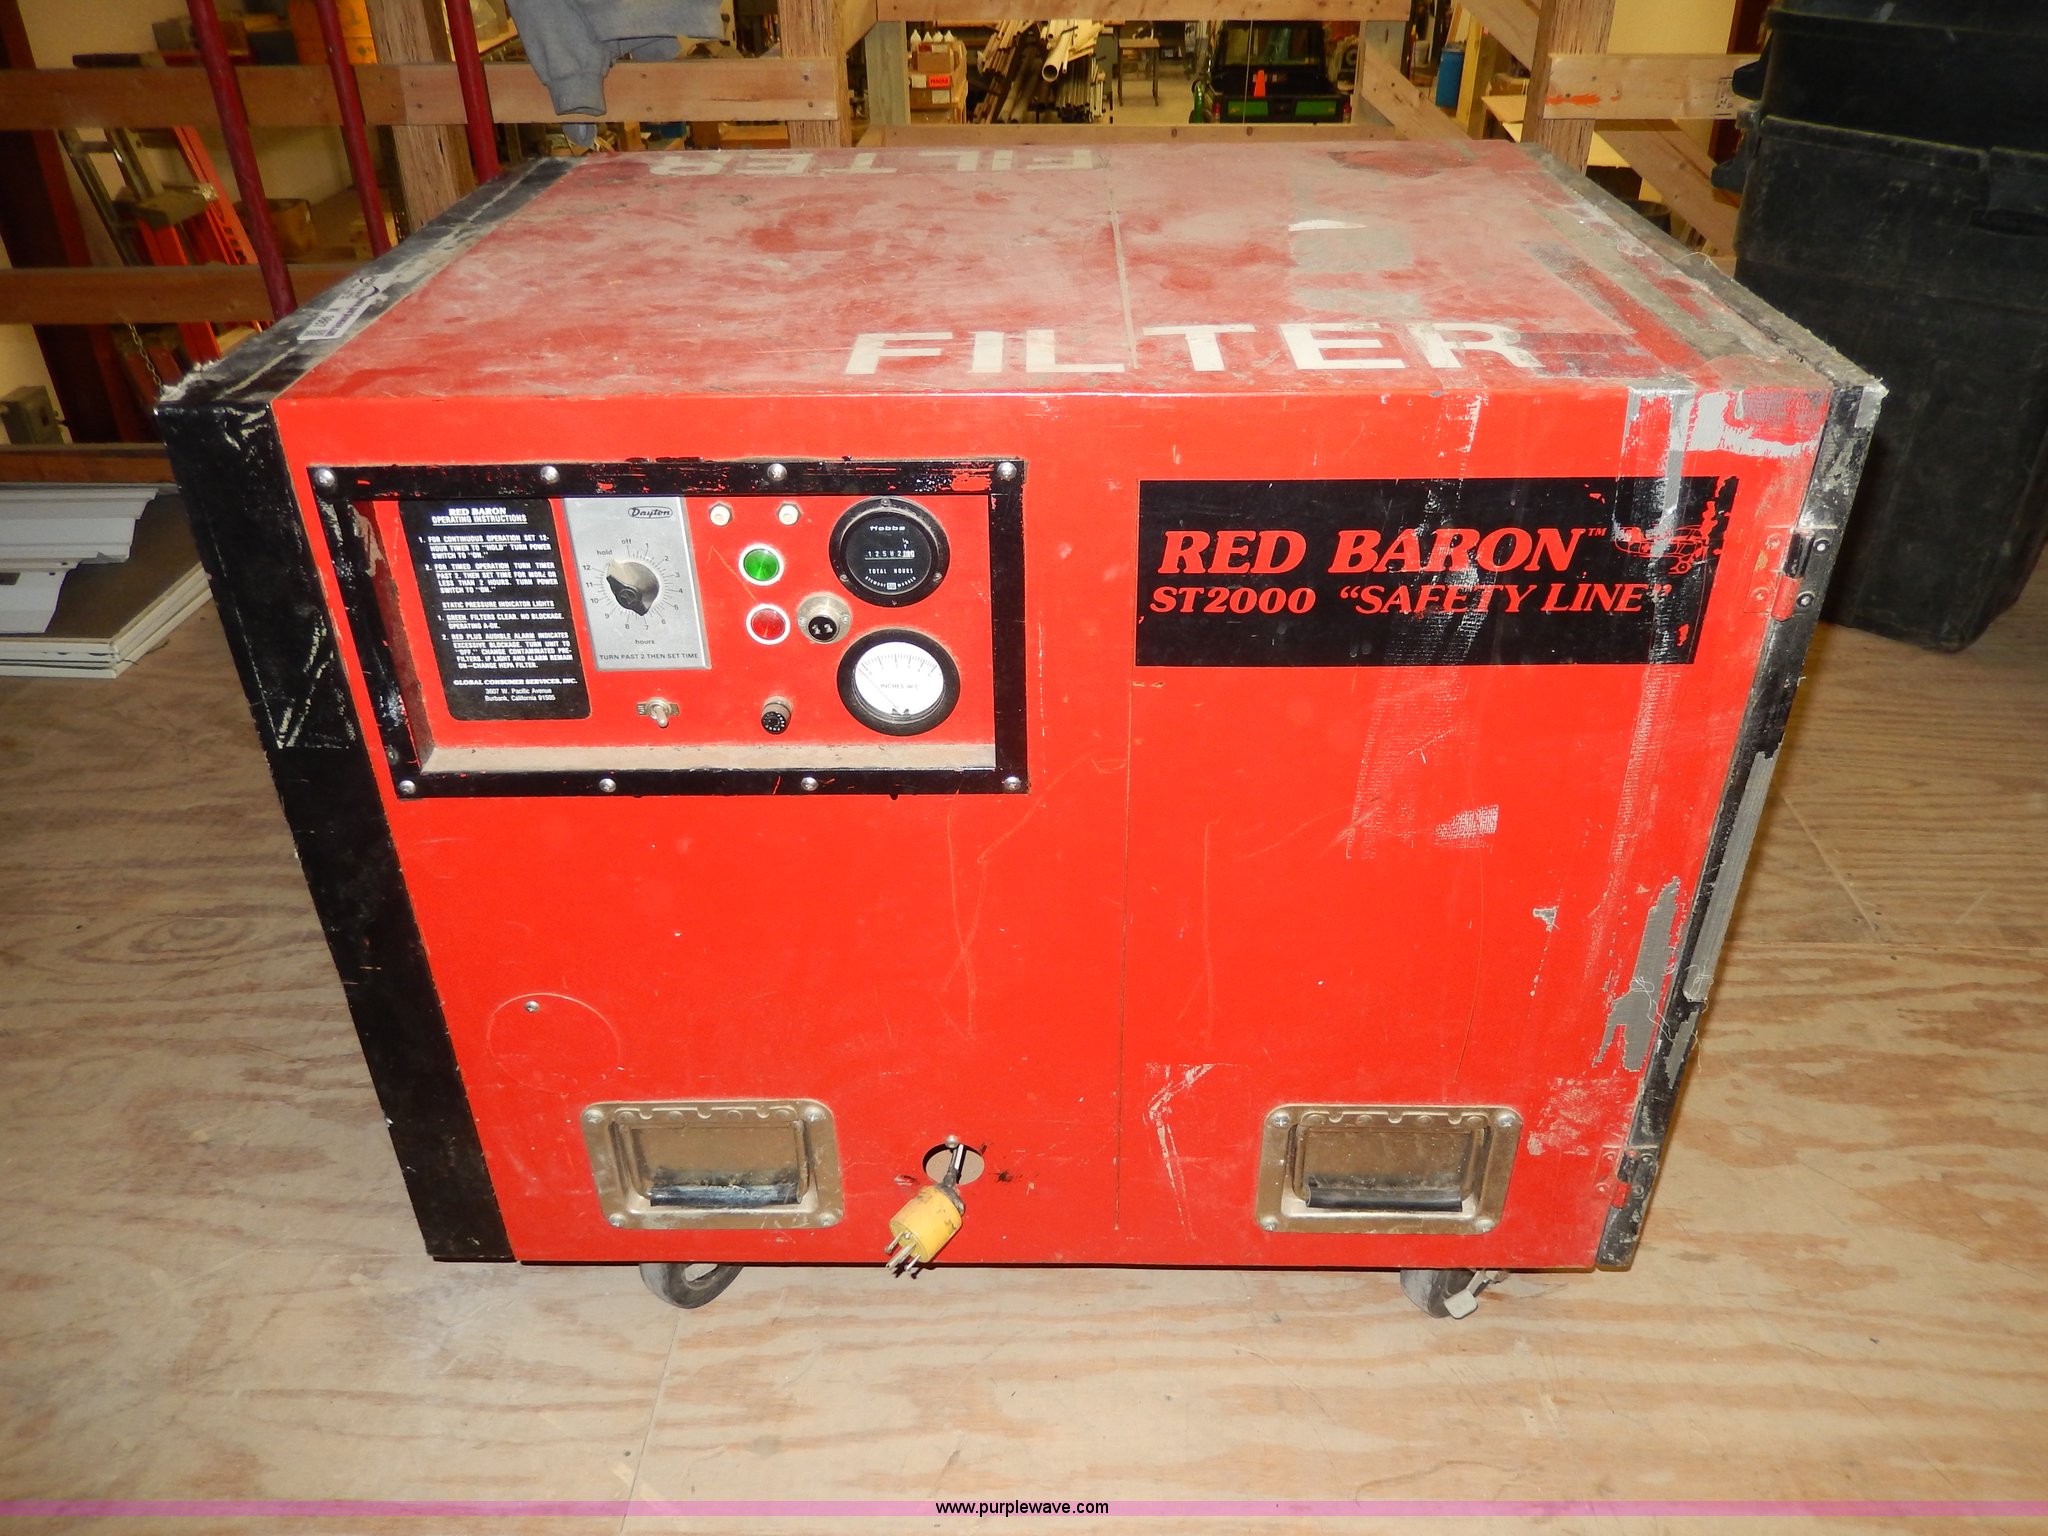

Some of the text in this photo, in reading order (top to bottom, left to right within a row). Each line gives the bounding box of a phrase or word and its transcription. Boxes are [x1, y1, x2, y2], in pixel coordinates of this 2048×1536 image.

[845, 322, 1542, 375] FILTER
[431, 514, 527, 524] OPERATING INSTRUCTIONS
[472, 507, 507, 515] BARON
[631, 506, 671, 519] Dayton
[1157, 530, 1308, 575] RED
[1328, 527, 1588, 574] BARON
[1149, 587, 1317, 615] ST2000
[1341, 583, 1539, 615] "SAFETY
